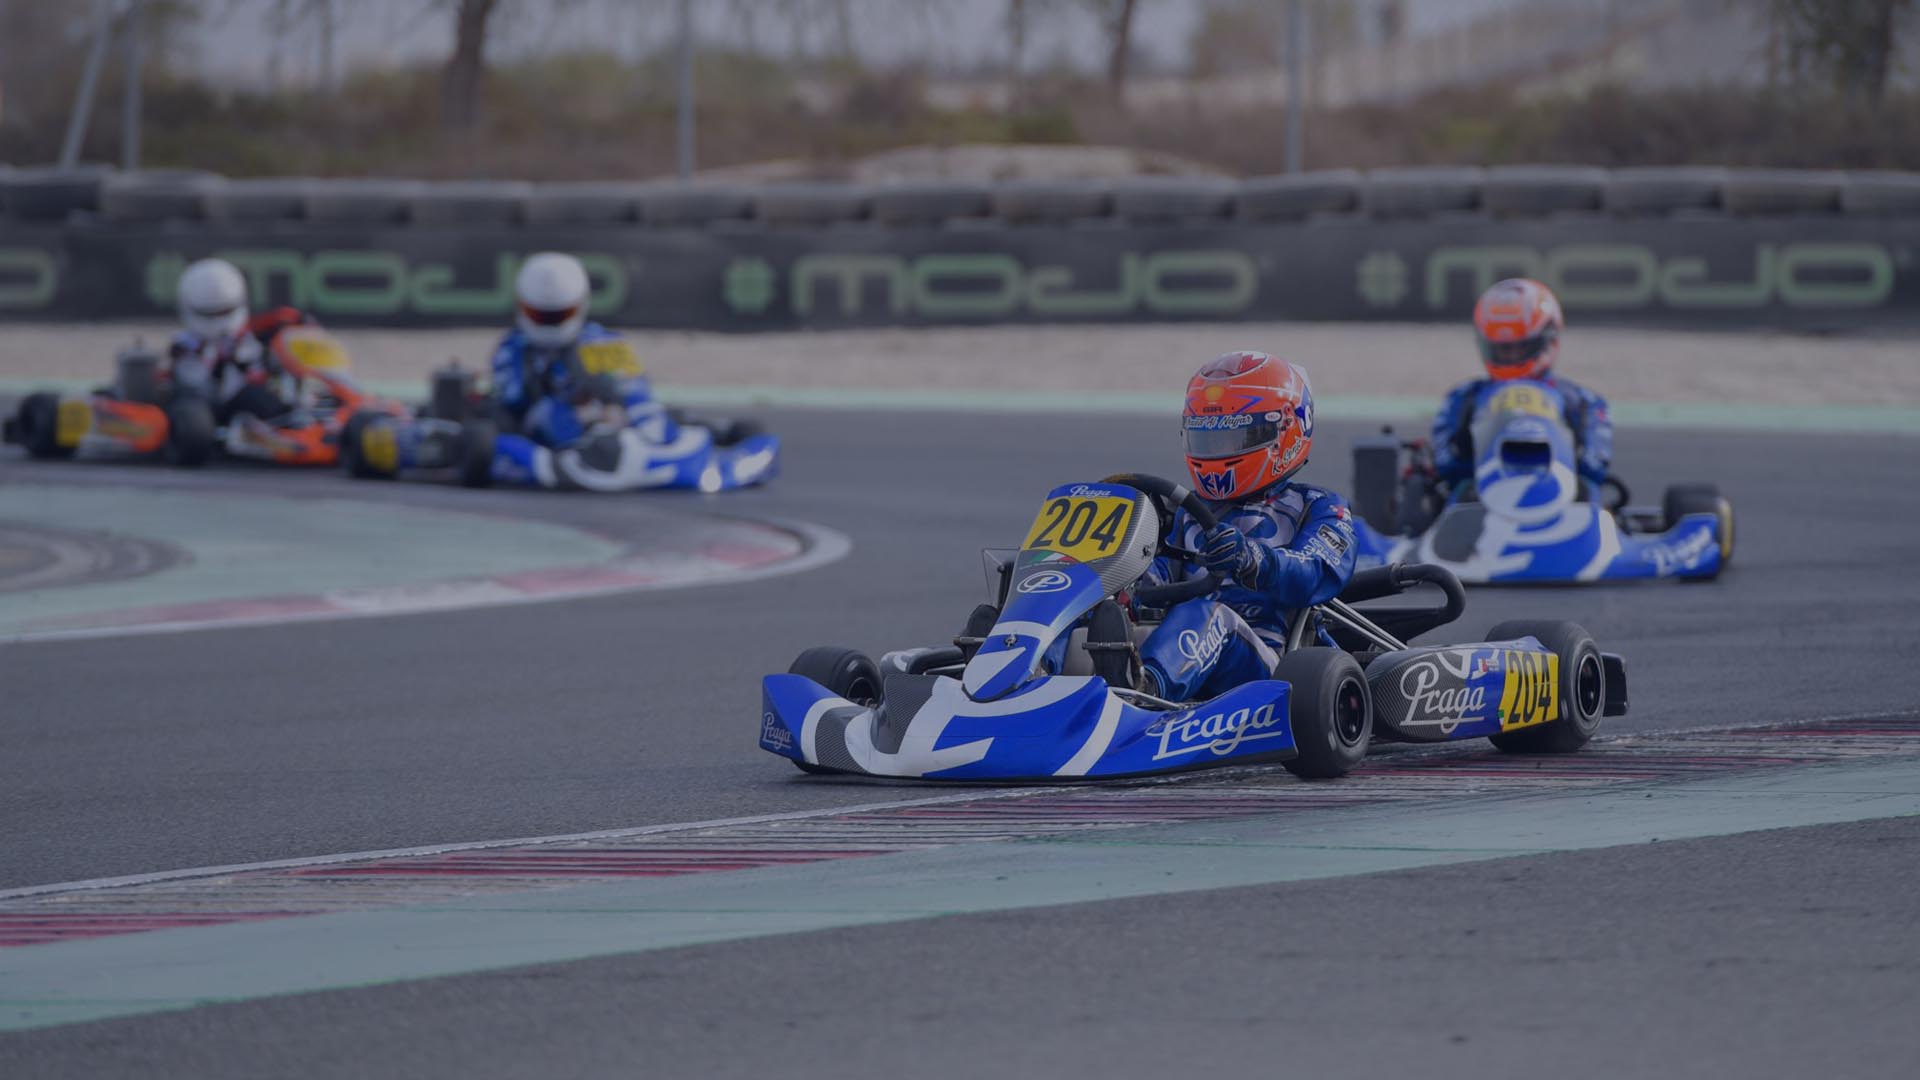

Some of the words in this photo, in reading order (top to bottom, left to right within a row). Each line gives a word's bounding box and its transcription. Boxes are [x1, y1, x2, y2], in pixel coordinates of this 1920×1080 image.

[1070, 485, 1113, 498] Praga
[1029, 498, 1128, 551] 204
[1400, 661, 1487, 734] Praga
[1507, 652, 1553, 724] 204
[763, 711, 793, 750] Praga
